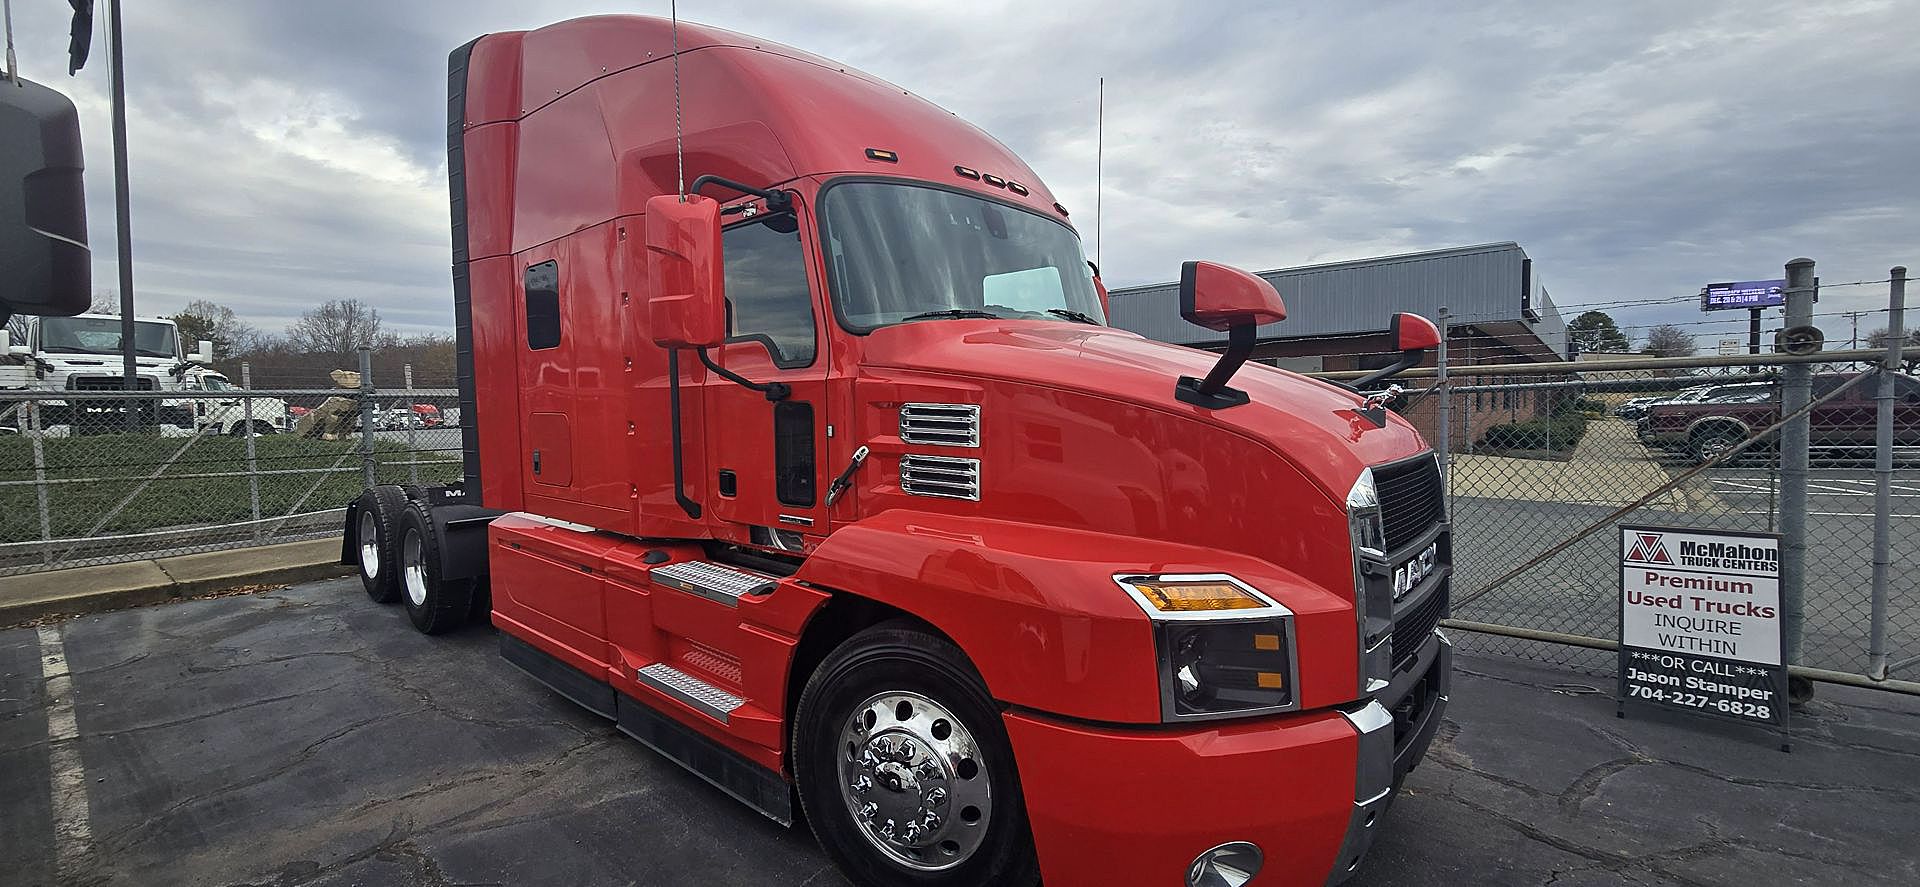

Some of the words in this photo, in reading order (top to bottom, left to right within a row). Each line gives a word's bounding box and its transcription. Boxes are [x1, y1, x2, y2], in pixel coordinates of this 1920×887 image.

[1680, 541, 1778, 561] McMahon
[1680, 556, 1720, 568] TRUCK
[1722, 558, 1778, 572] CENTERS
[1645, 571, 1753, 594] Premium
[1627, 590, 1682, 610] Used
[1690, 596, 1776, 619] Trucks
[1654, 613, 1742, 636] INQUIRE
[1658, 633, 1737, 656] WITHIN
[1627, 668, 1681, 687] Jason
[1685, 676, 1773, 701] Stamper
[1629, 684, 1770, 719] 704-227-6828
